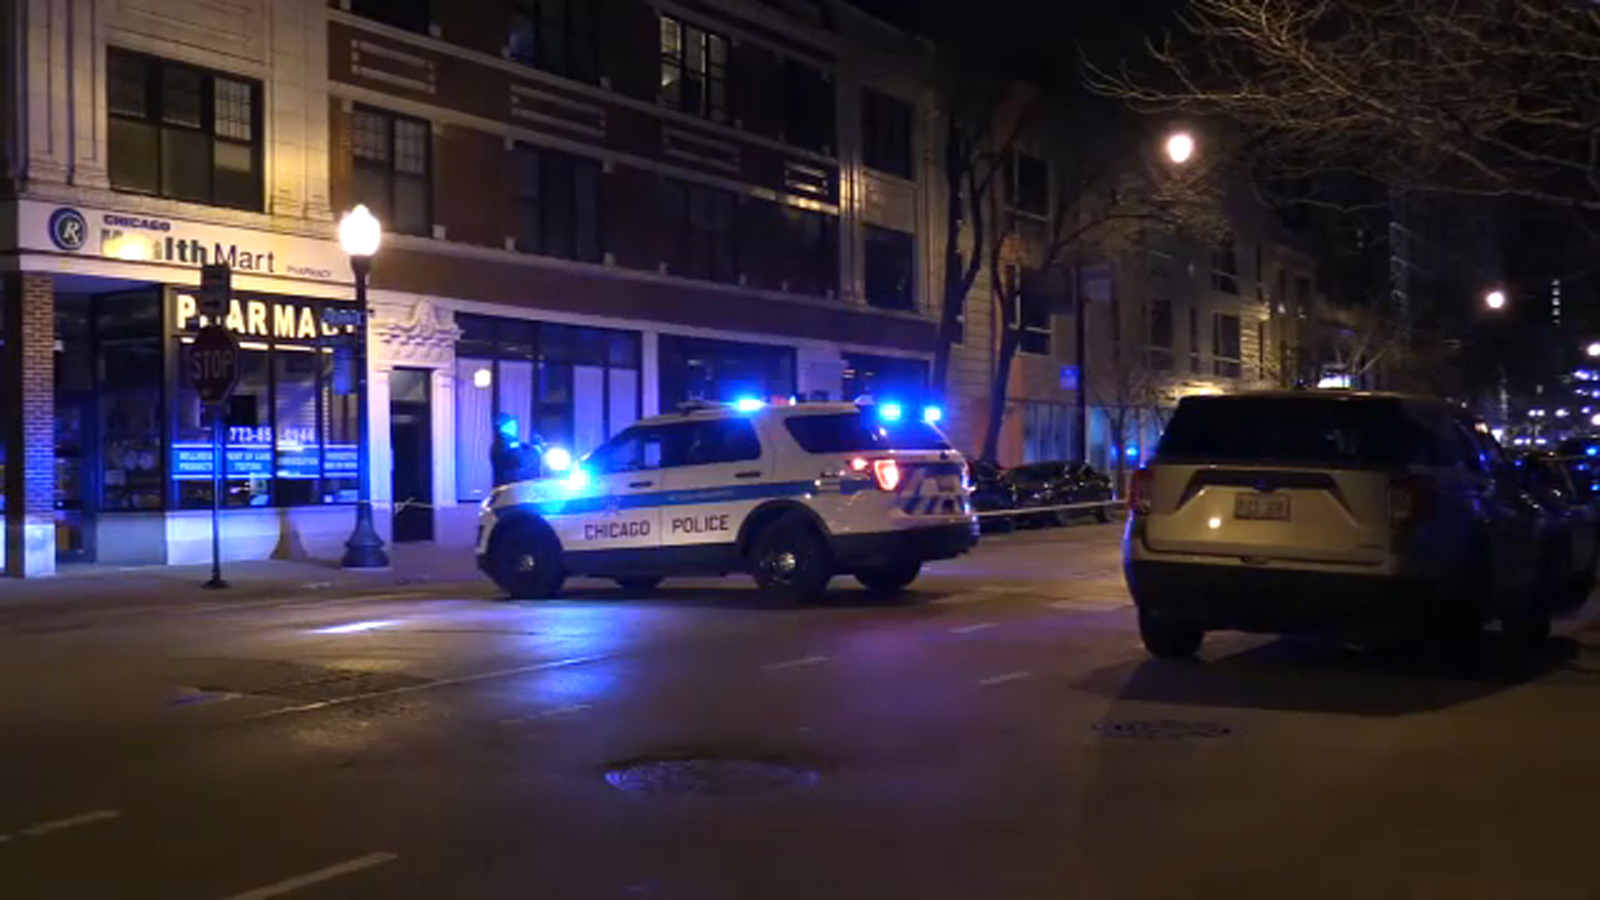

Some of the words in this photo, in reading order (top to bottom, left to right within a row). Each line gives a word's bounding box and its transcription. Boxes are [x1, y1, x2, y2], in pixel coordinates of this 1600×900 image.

[102, 213, 172, 232] CHICAGO
[214, 241, 276, 273] Mart
[176, 294, 355, 339] PARMA
[191, 350, 234, 380] STOP
[229, 426, 316, 442] 773-85-0944
[584, 519, 651, 542] CHICAGO
[671, 513, 730, 535] POLICE
